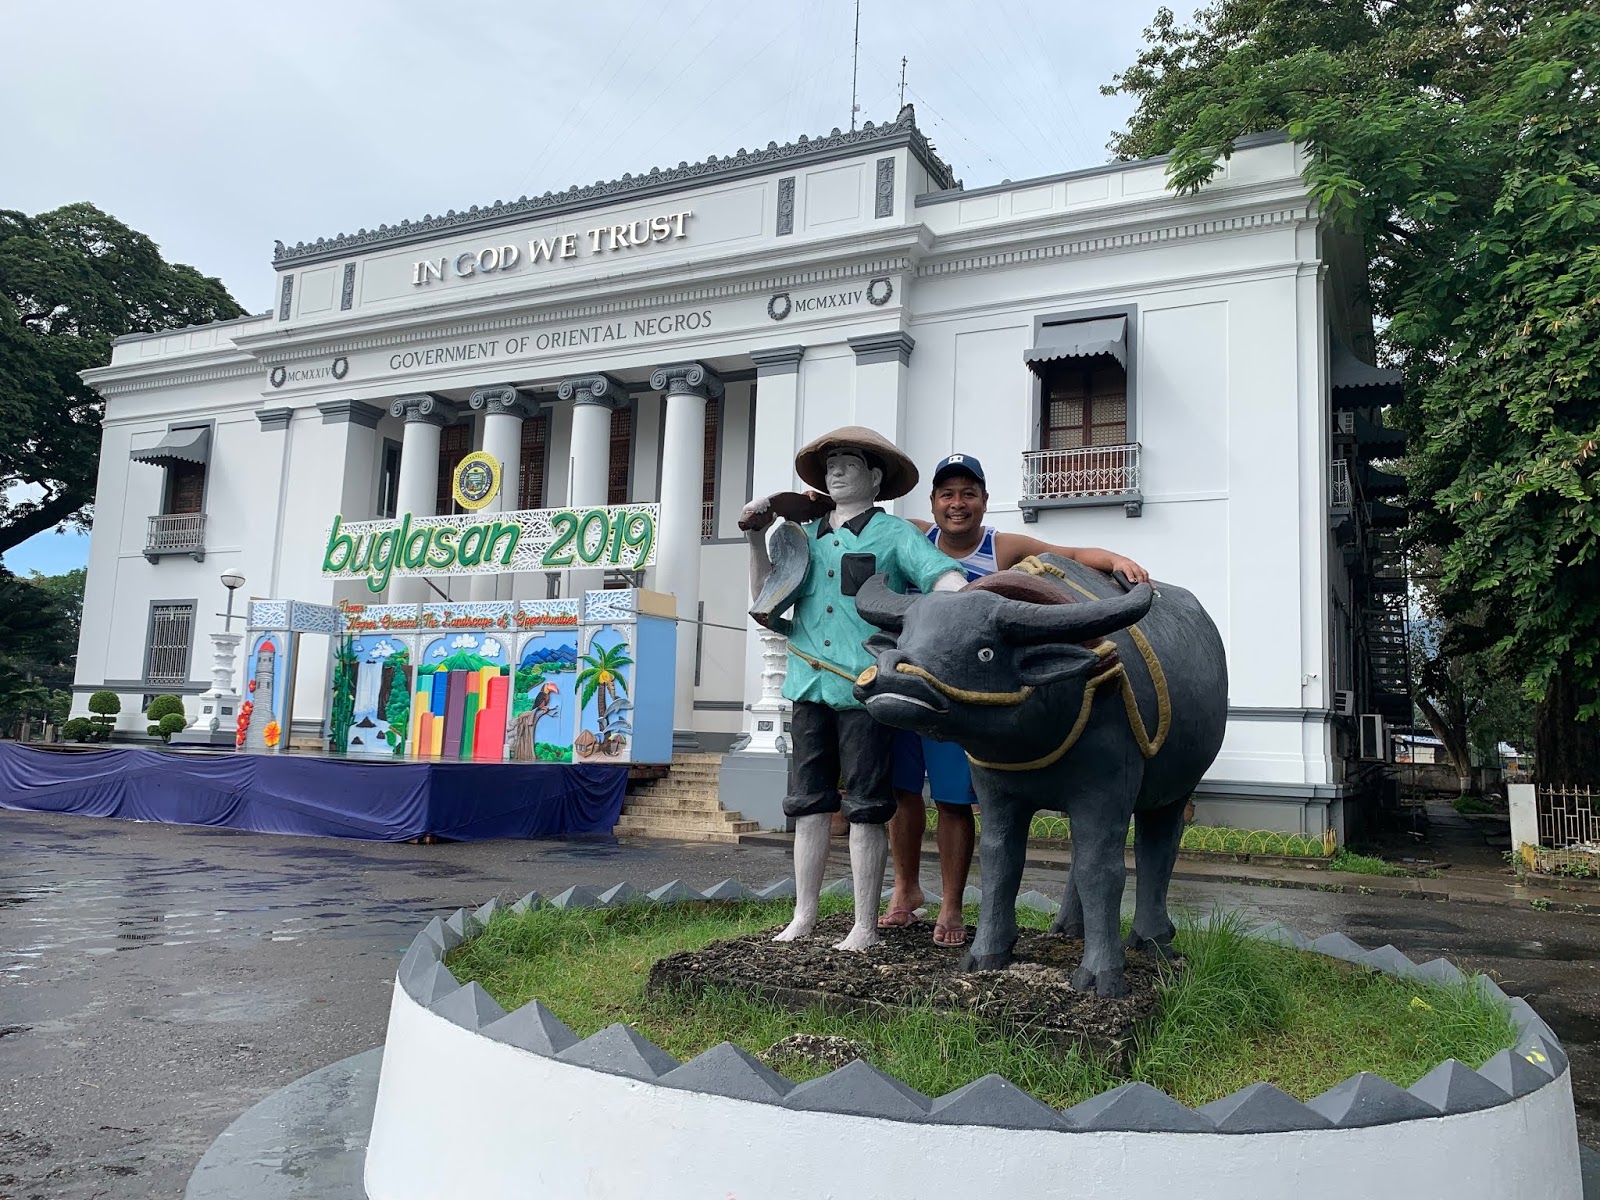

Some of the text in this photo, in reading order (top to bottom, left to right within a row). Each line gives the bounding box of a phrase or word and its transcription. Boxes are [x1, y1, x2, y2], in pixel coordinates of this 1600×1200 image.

[411, 211, 692, 285] IN GOD WE TRUST
[795, 291, 862, 312] MCMXXIV
[389, 310, 712, 369] GOVERNMENT OF ORIENTAL NEGROS
[287, 367, 331, 382] MCMXXIV
[322, 509, 657, 594] buglasan 2019
[422, 612, 440, 628] The
[441, 611, 493, 630] Landscape
[496, 612, 509, 629] of
[513, 610, 578, 630] Opportunities
